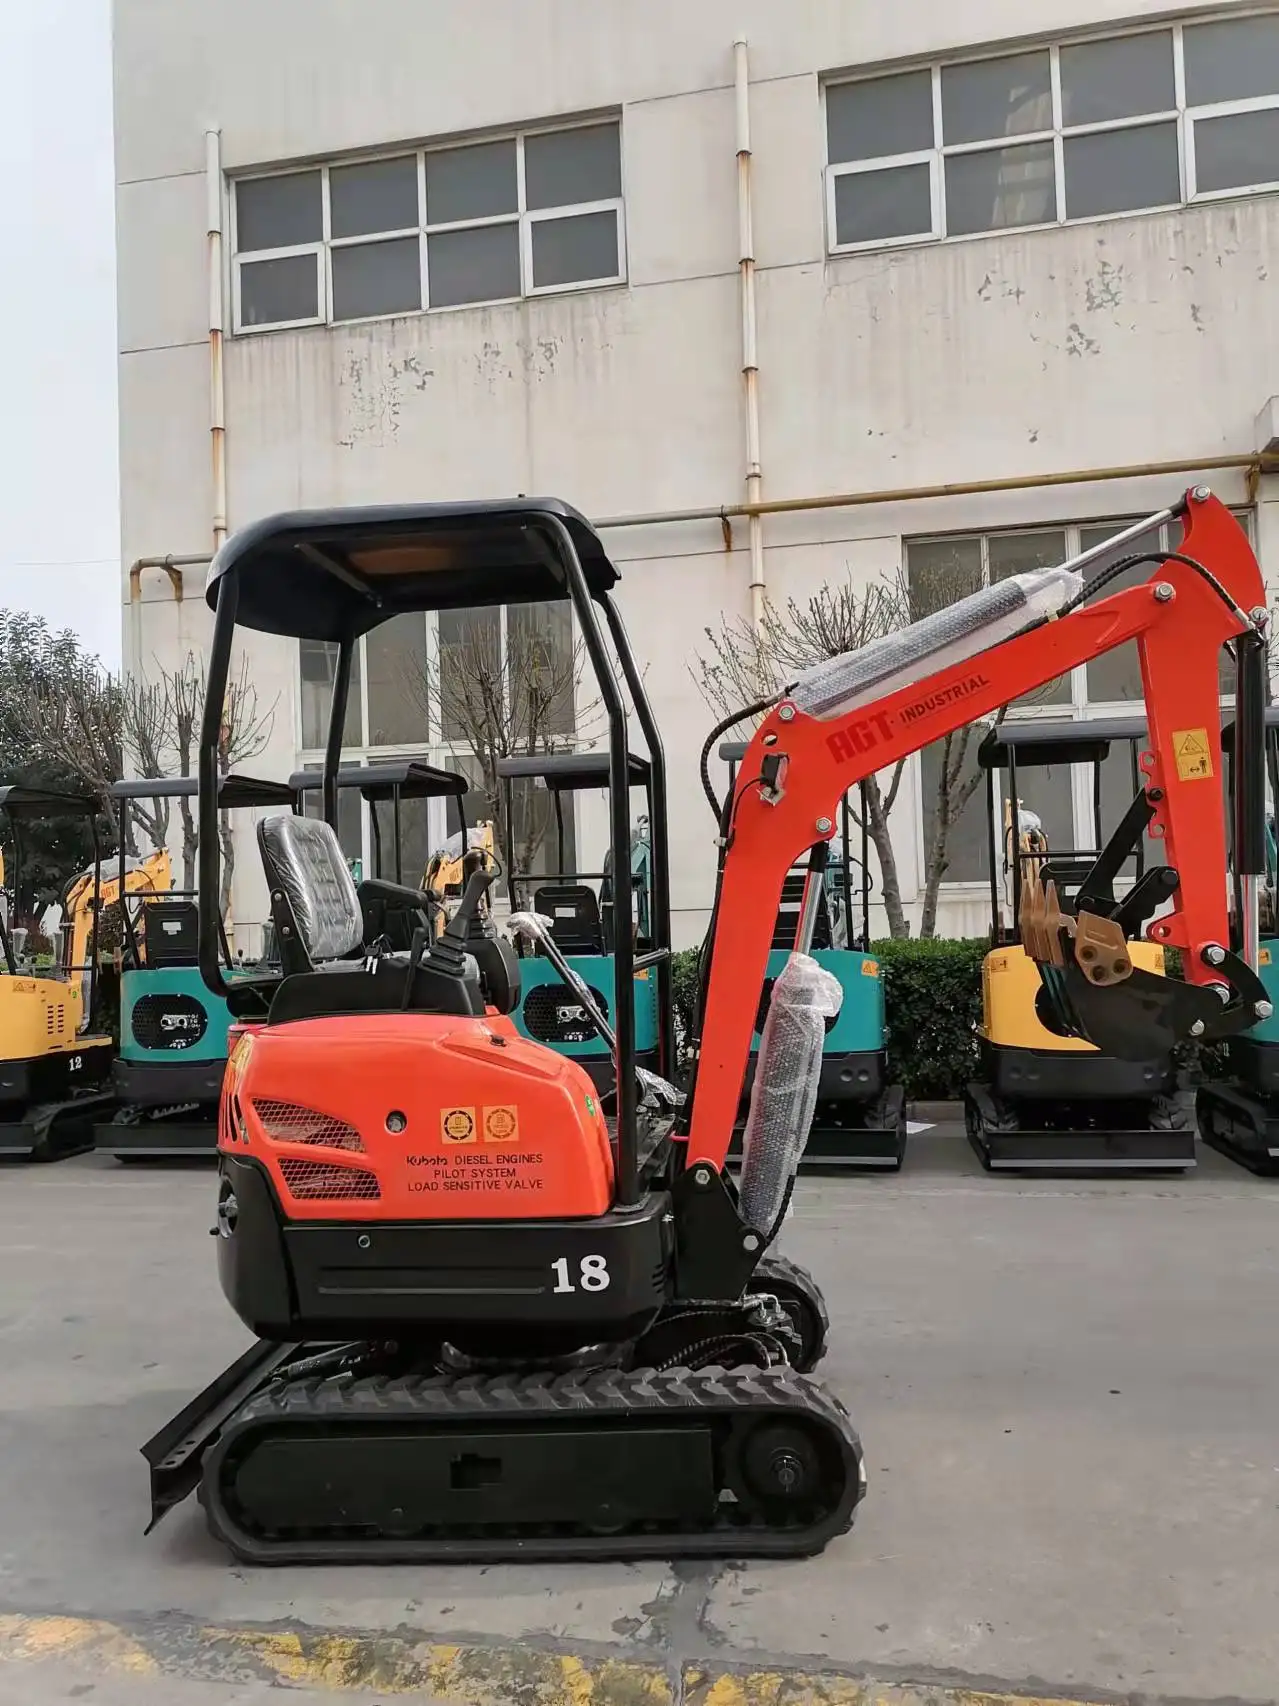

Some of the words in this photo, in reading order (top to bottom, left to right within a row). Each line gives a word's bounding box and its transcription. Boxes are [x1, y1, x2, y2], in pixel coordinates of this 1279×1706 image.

[825, 711, 894, 764] AGT
[900, 674, 989, 723] INDUSTRIAL
[69, 1056, 82, 1071] 12
[454, 1155, 493, 1165] DIESEL
[496, 1154, 543, 1164] ENGINES
[434, 1169, 465, 1178] PILOT
[471, 1168, 516, 1178] SYSTEM
[408, 1182, 438, 1191] LOAD
[443, 1180, 501, 1191] SENSITIVE
[505, 1180, 543, 1189] VALVE
[551, 1254, 610, 1293] 18
